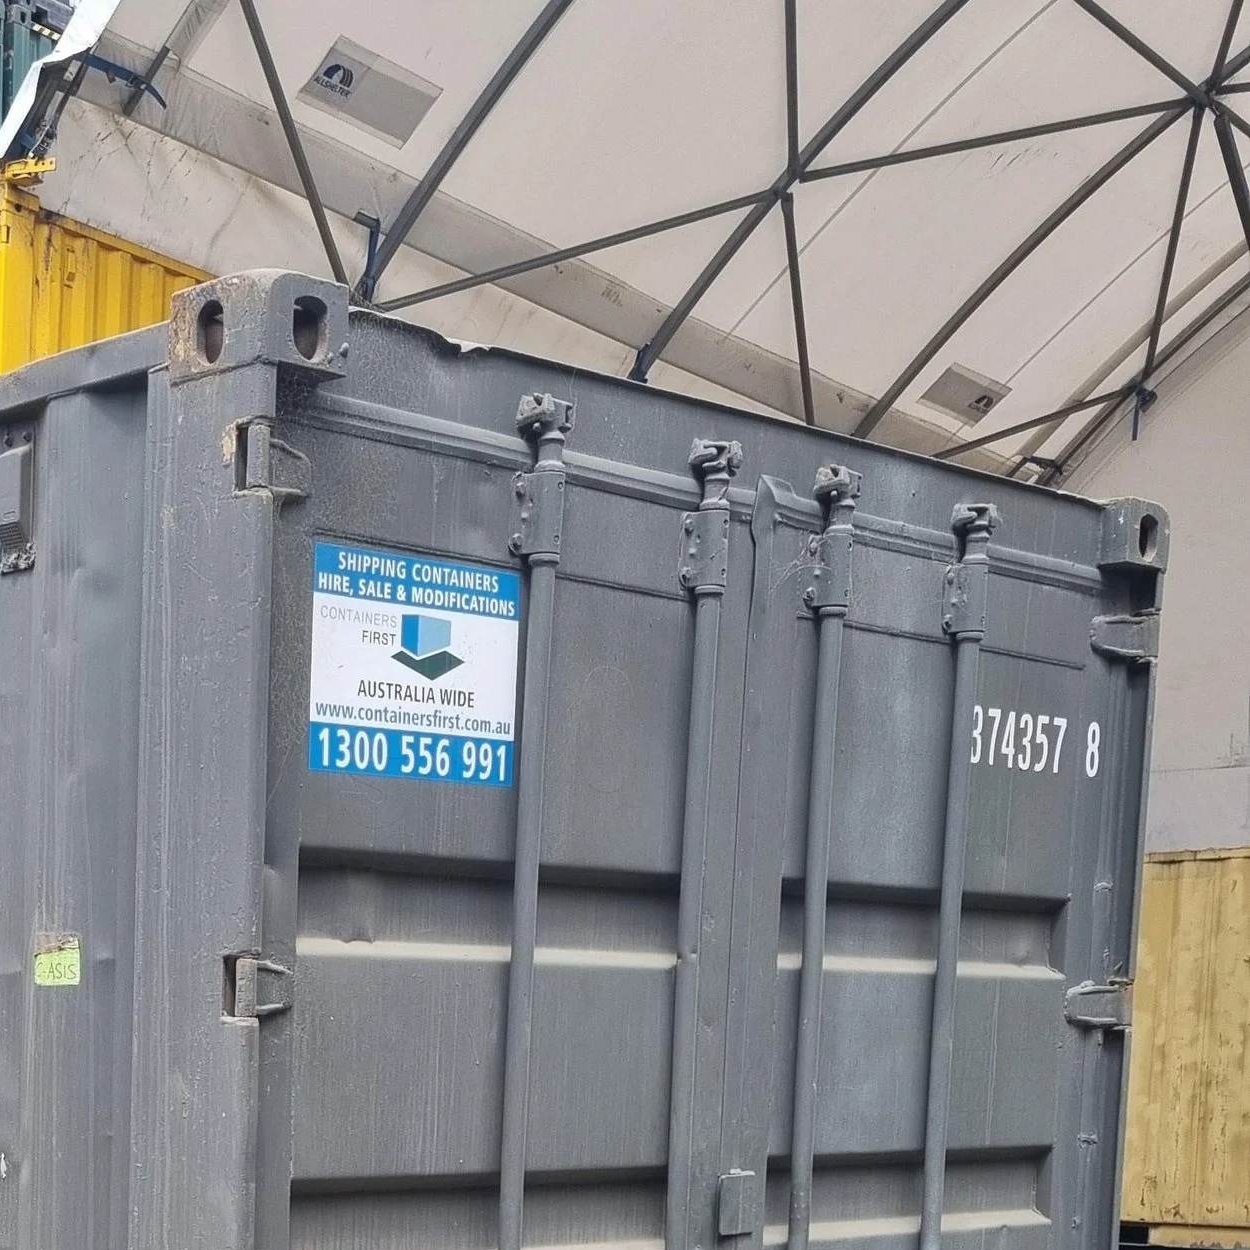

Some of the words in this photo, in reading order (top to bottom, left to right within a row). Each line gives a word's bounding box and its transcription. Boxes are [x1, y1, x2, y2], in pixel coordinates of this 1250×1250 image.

[338, 551, 407, 580] SHIPPING
[412, 564, 499, 593] CONTAINERS
[318, 572, 353, 597] HIRE,
[358, 579, 391, 599] SALE
[397, 585, 407, 601] &
[411, 586, 515, 617] MODIFICATIONS
[320, 604, 397, 628] CONTAINERS
[362, 630, 396, 647] FIRST
[357, 679, 435, 704] AUSTRALIA
[440, 689, 475, 708] WIDE
[315, 702, 511, 735] www.containersfirst.com.au
[318, 727, 388, 771] 1300
[401, 735, 450, 776] 556
[462, 741, 506, 782] 991
[970, 704, 1067, 774] 374357
[1085, 721, 1100, 778] 8
